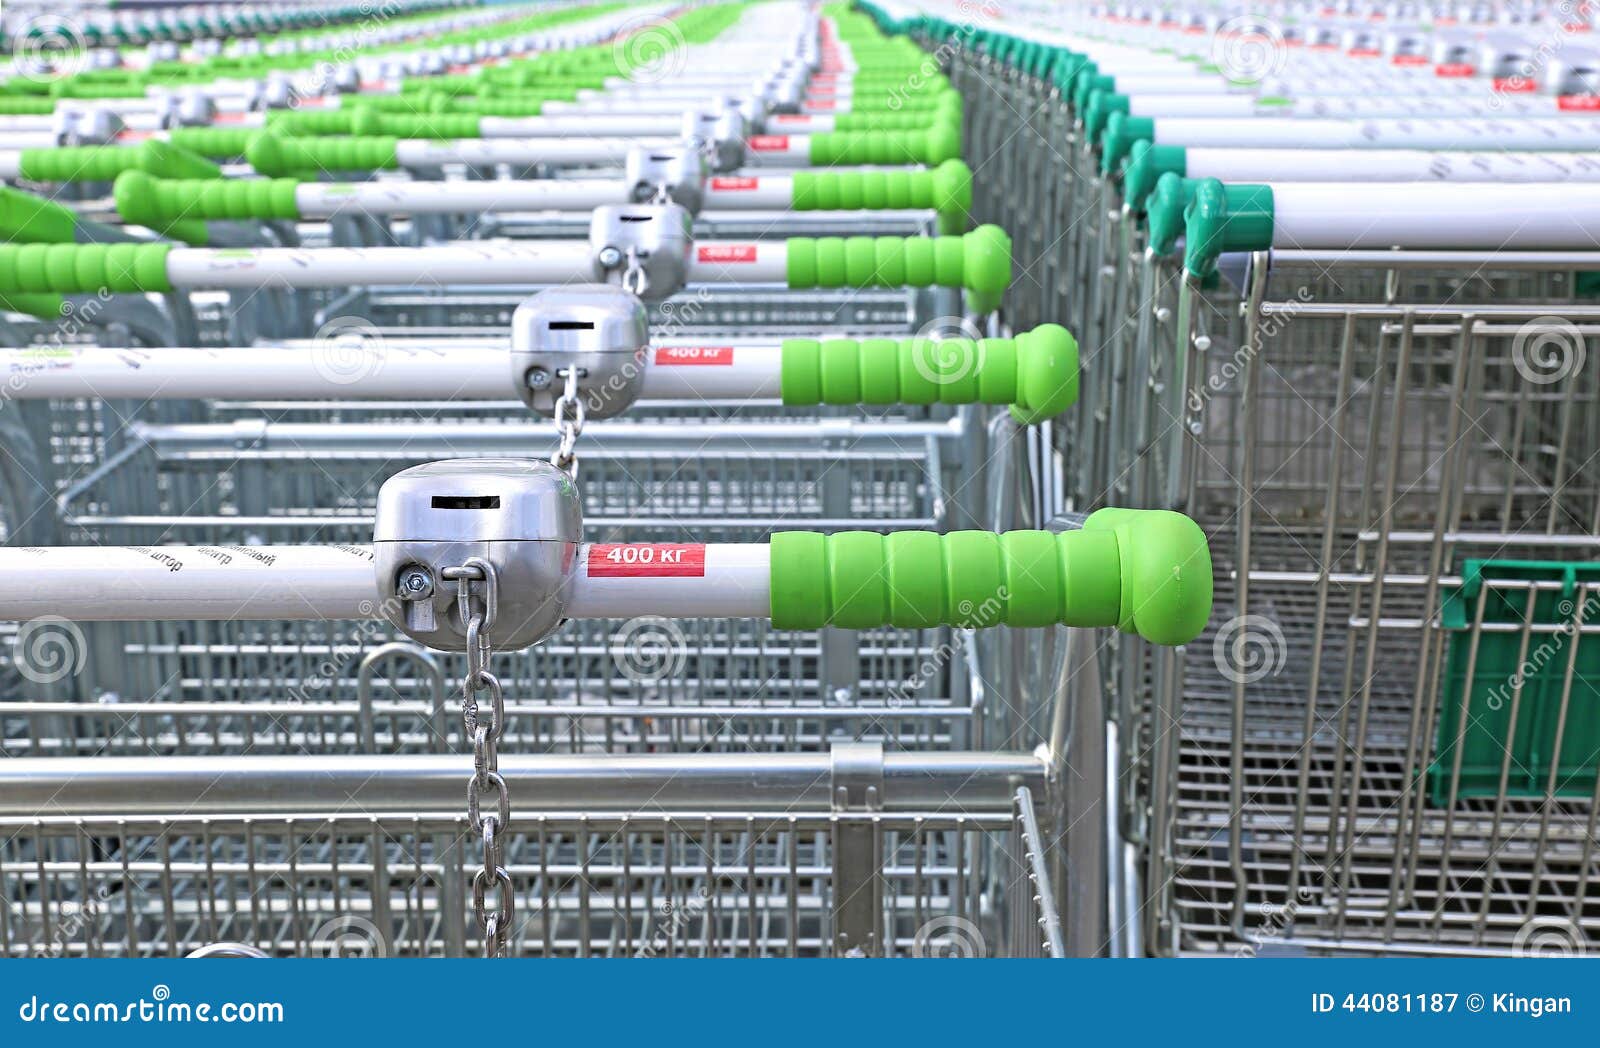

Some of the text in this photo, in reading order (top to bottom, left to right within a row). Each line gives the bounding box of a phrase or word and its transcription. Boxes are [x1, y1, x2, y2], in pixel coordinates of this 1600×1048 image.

[150, 551, 184, 573] штор
[606, 547, 687, 564] 400 кг
